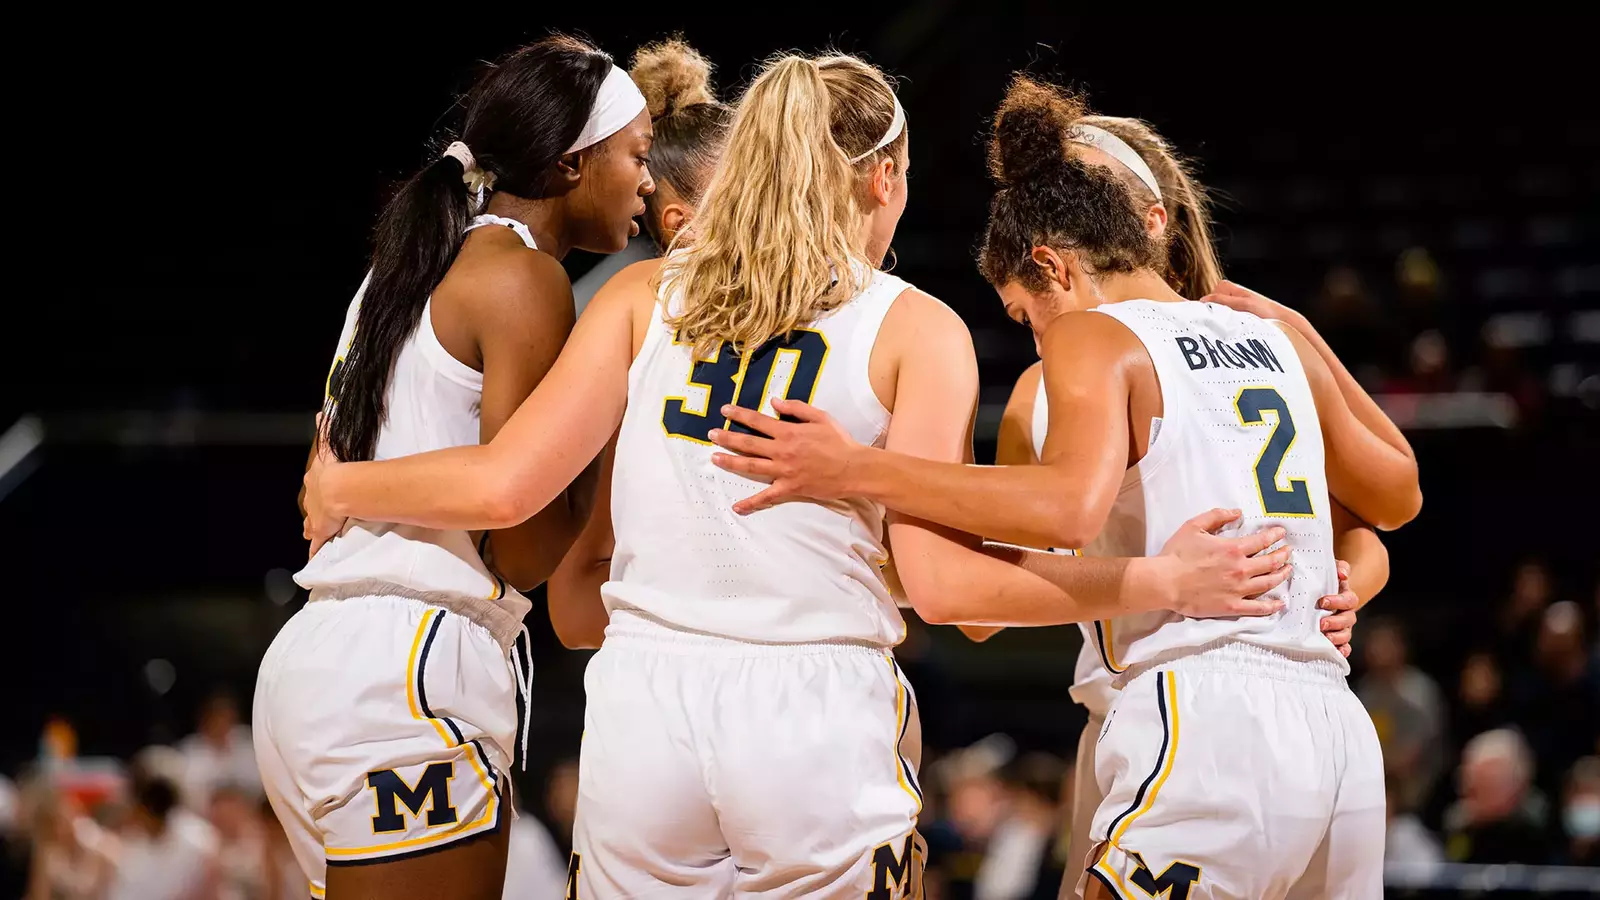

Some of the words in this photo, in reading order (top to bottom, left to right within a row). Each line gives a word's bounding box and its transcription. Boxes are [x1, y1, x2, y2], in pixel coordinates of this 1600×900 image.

[661, 327, 831, 446] 30
[1175, 334, 1285, 373] BROWN
[1233, 385, 1317, 518] 2
[365, 760, 459, 835] M
[865, 829, 914, 900] M
